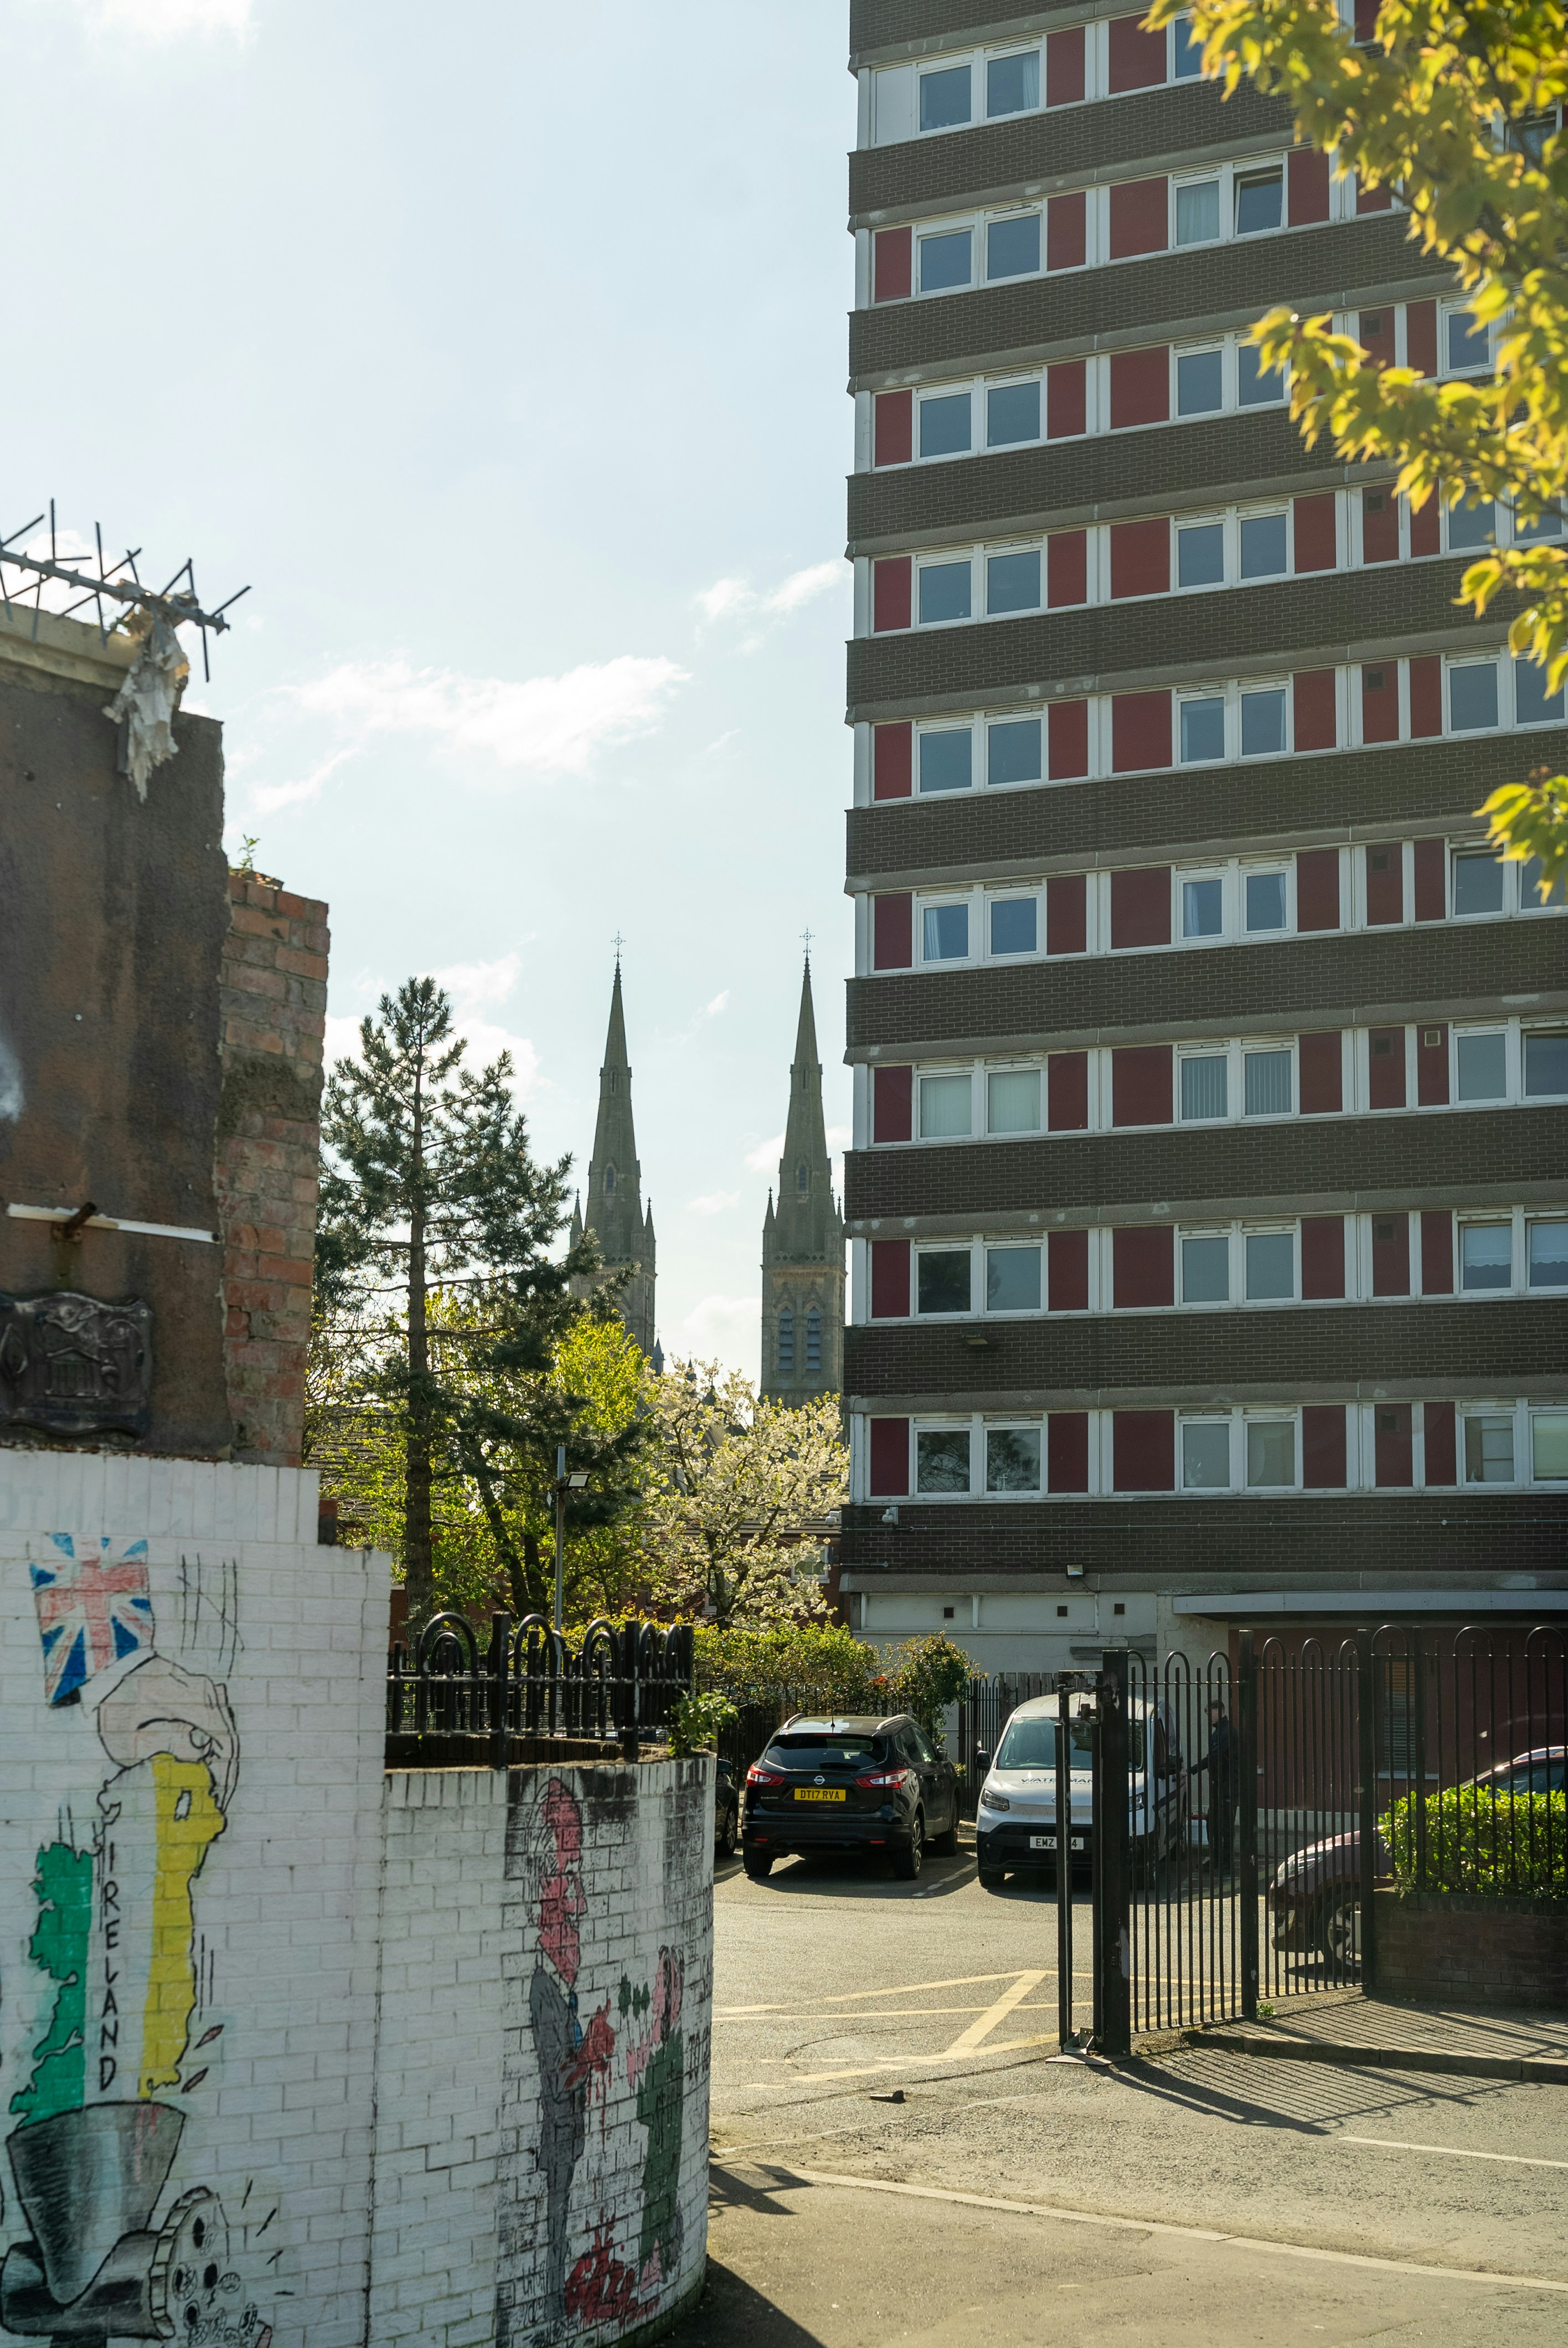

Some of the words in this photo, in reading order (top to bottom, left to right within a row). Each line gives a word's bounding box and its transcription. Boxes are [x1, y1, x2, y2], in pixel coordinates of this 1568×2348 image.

[800, 1790, 820, 1799] DT17
[822, 1790, 840, 1800] RVA
[100, 1842, 120, 2092] IRELAND
